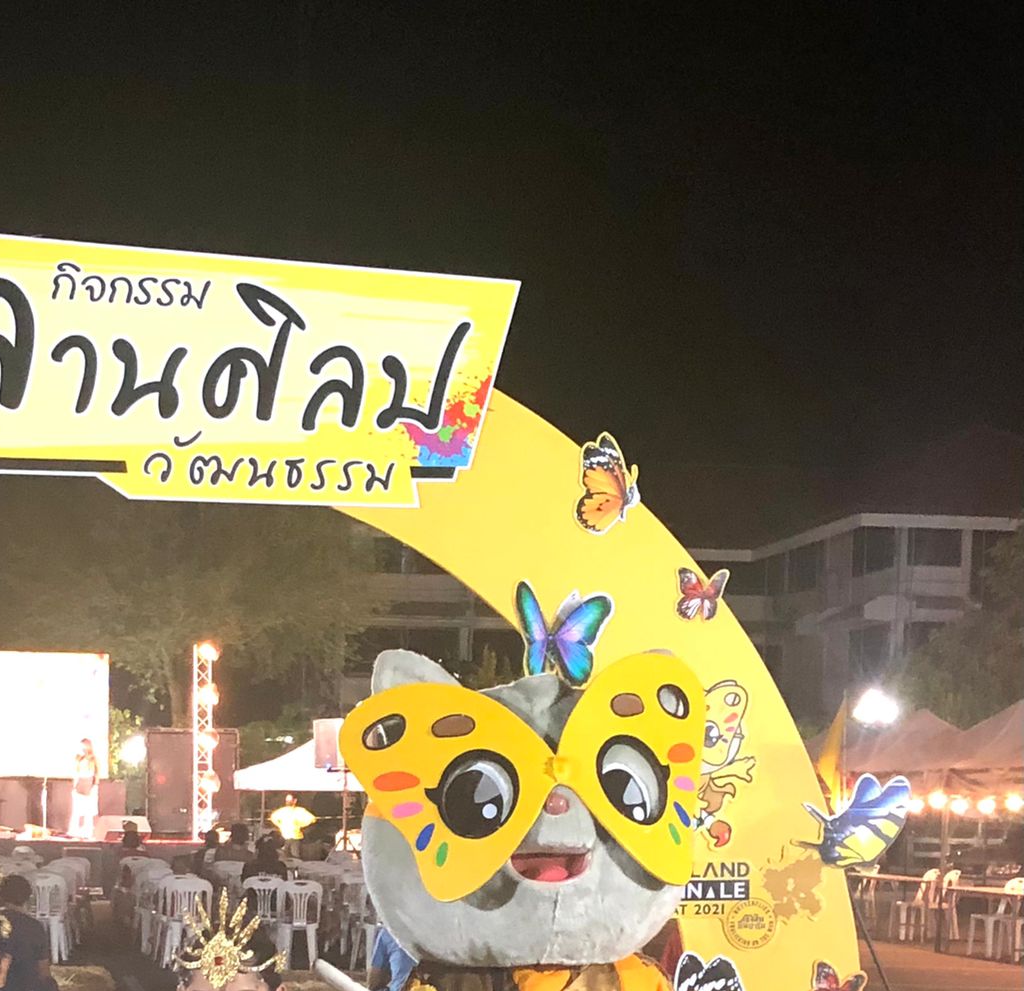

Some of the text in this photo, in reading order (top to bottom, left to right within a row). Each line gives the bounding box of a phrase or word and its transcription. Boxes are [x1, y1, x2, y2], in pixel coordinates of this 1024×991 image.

[52, 262, 211, 309] กิจกรรม
[144, 430, 394, 492] วัฒนธรรม
[691, 862, 749, 877] LAND
[682, 882, 745, 899] NALE
[694, 904, 724, 914] 2021
